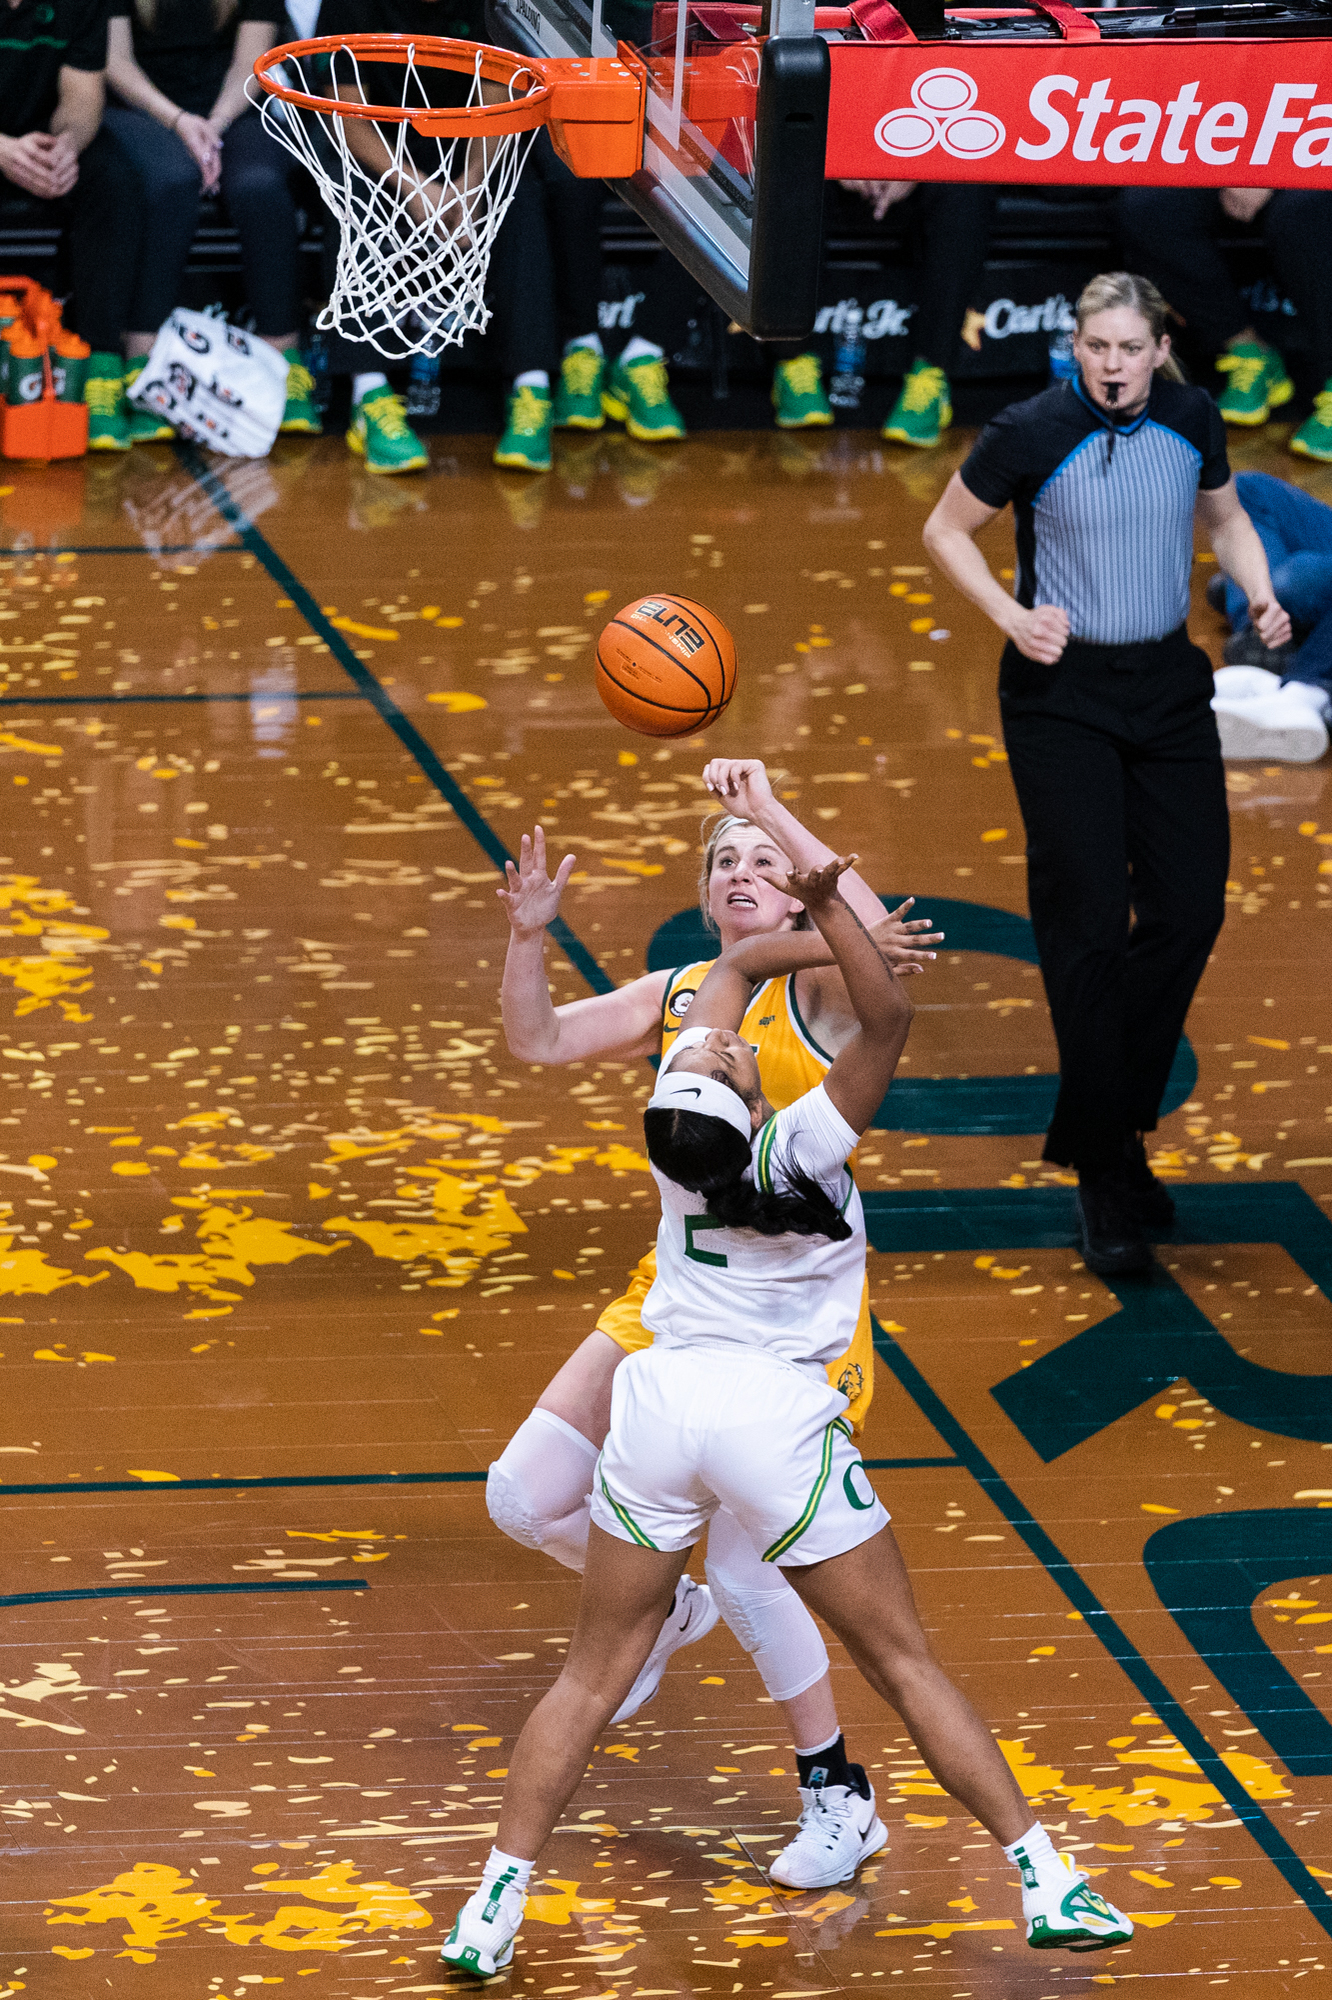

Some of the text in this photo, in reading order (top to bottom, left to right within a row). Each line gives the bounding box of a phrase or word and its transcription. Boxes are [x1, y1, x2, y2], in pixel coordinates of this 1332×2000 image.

[630, 612, 692, 659] CHANSHIP
[635, 600, 706, 655] ELITE
[1033, 1919, 1044, 1929] 07
[465, 1950, 477, 1961] 07
